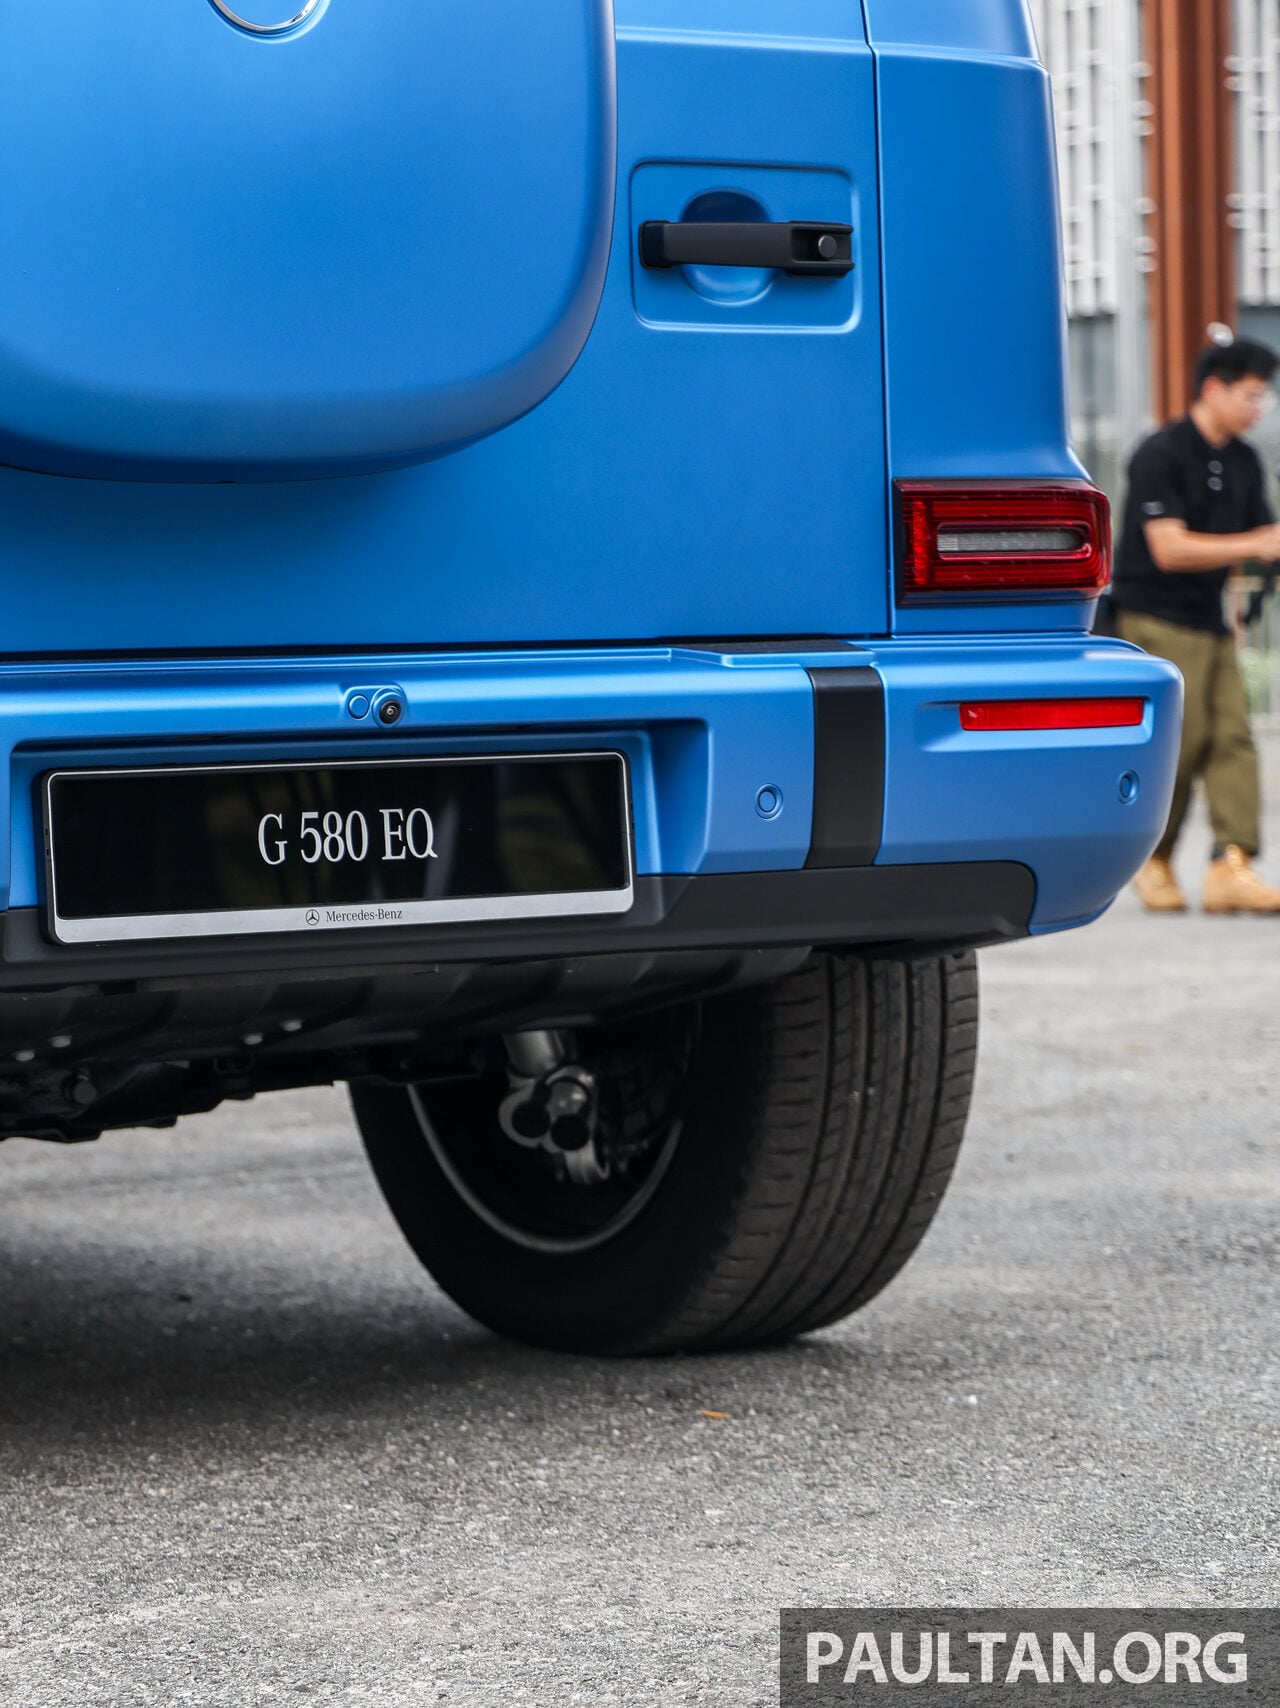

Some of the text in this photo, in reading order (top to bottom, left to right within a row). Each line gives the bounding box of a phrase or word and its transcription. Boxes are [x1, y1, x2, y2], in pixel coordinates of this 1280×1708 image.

[258, 807, 438, 865] G 580 EQ
[326, 908, 402, 922] Mercedes-Benz
